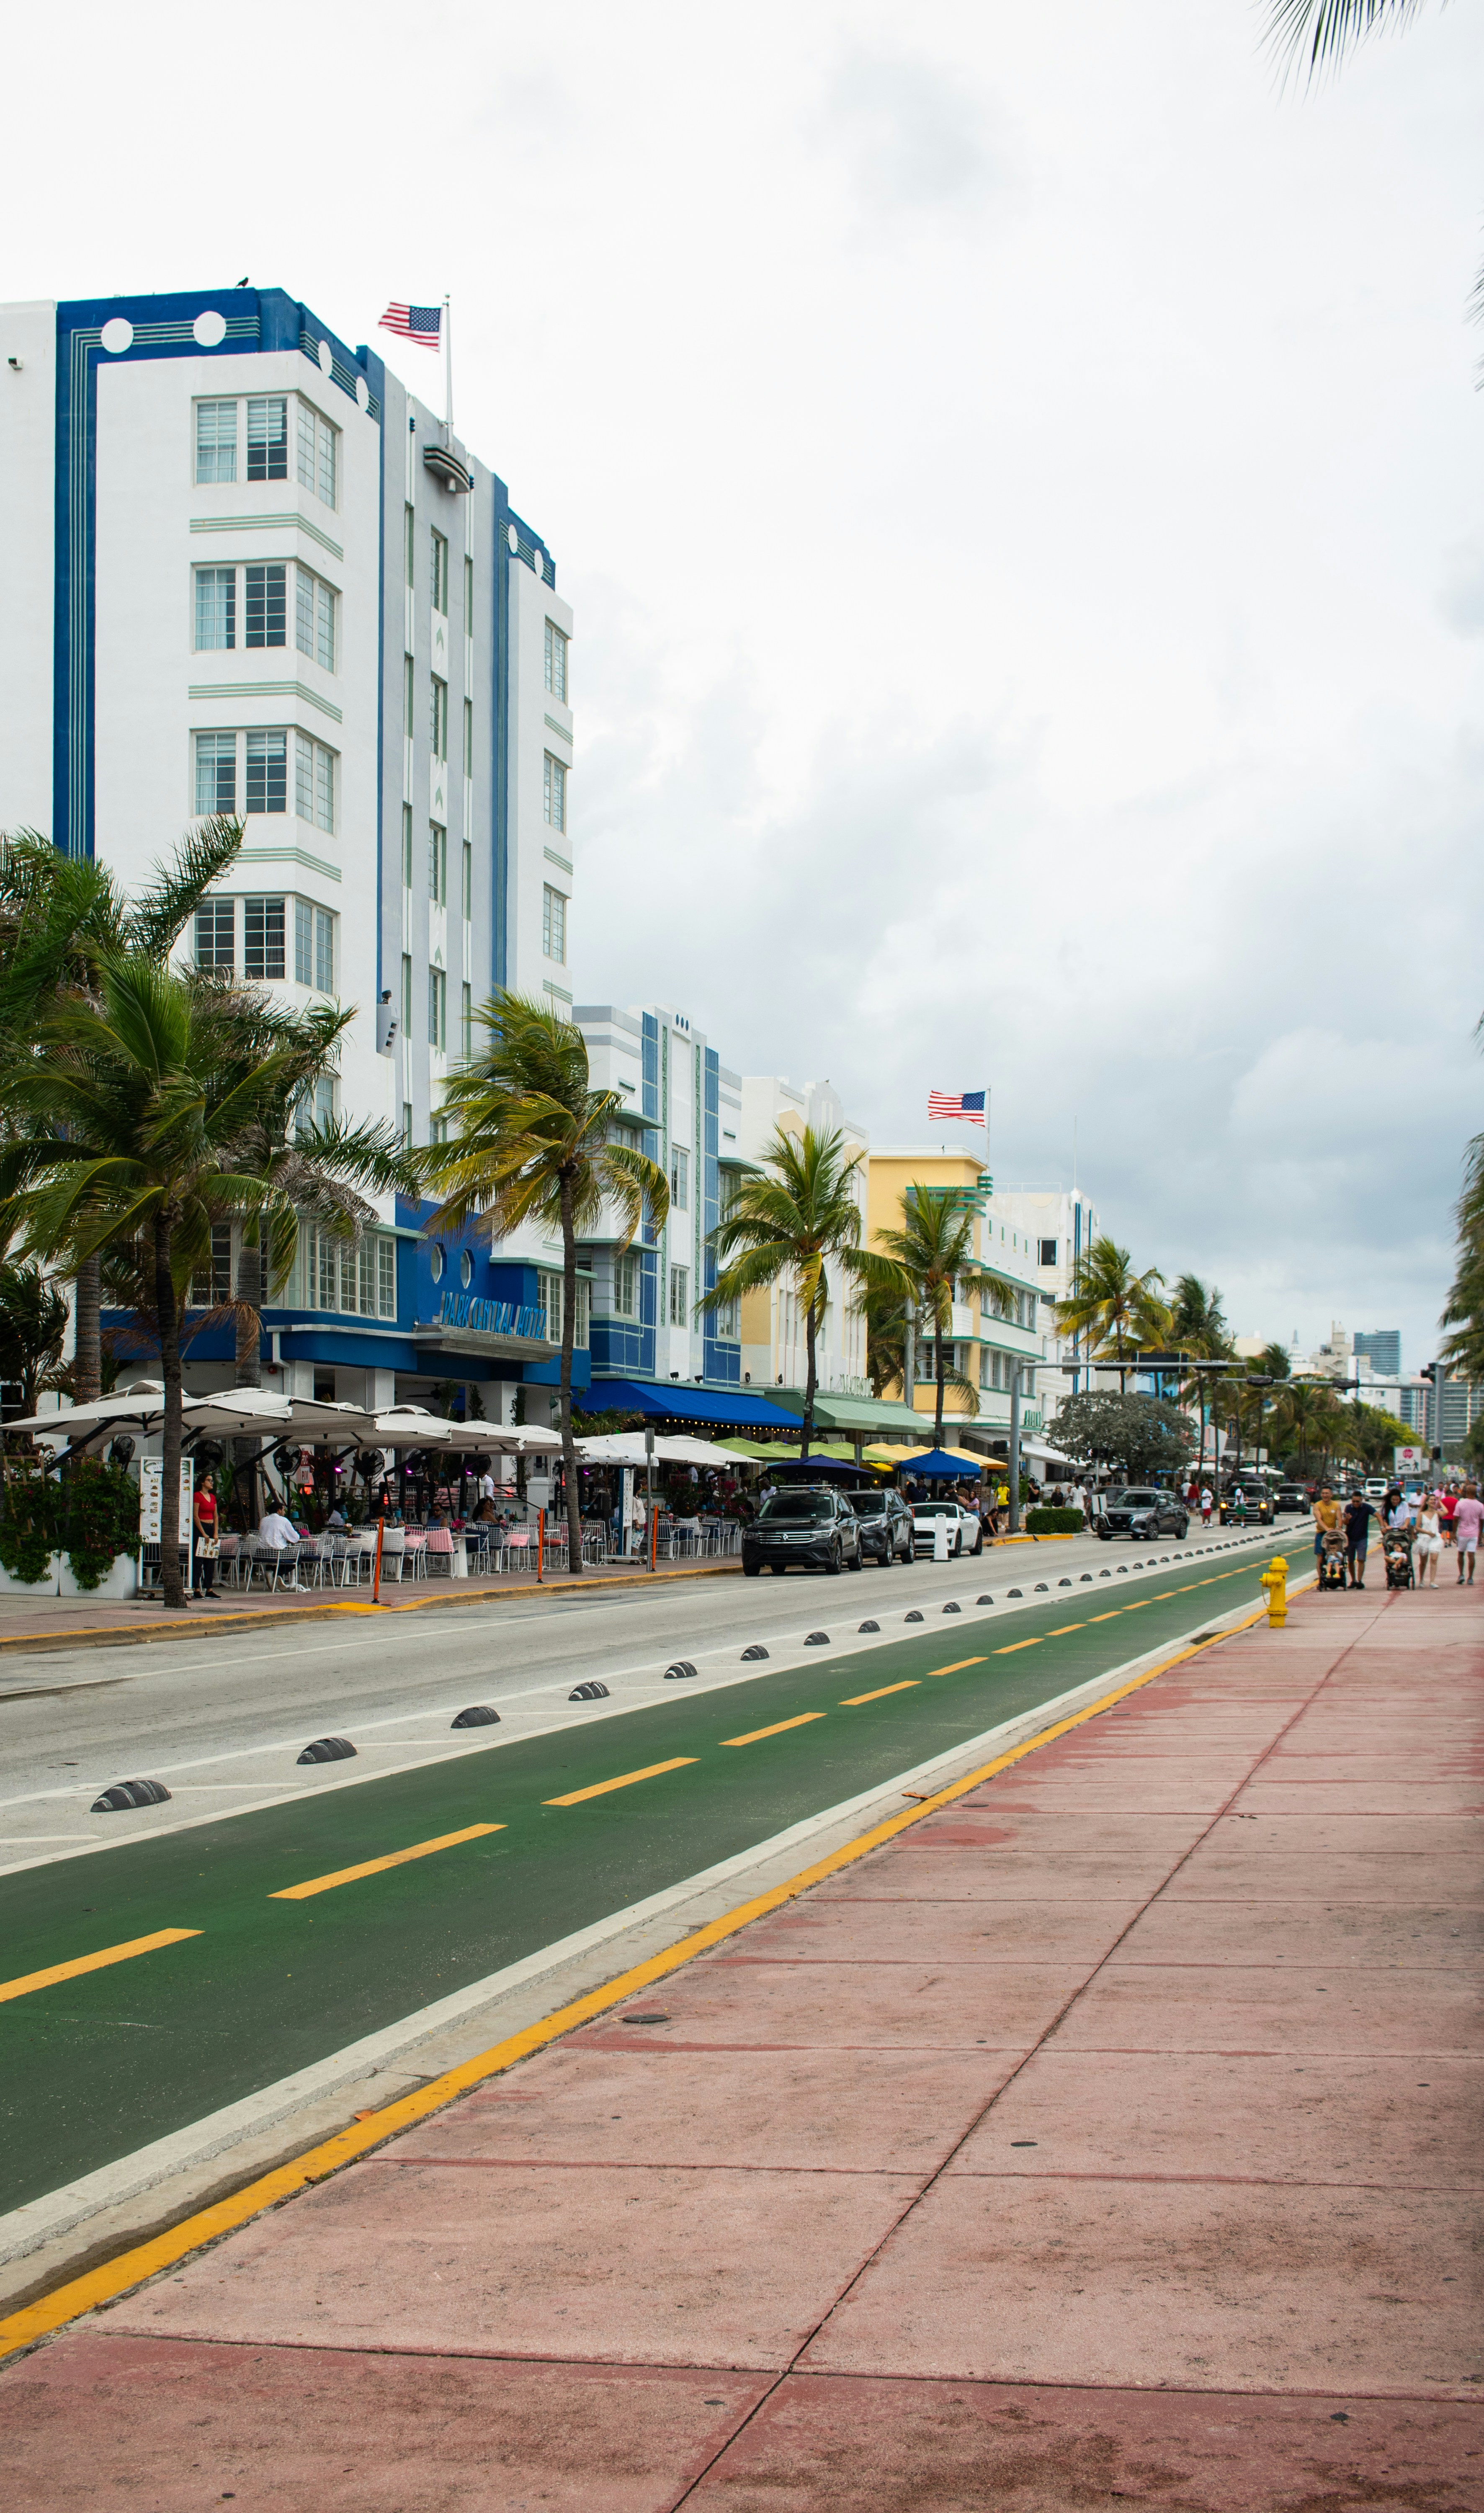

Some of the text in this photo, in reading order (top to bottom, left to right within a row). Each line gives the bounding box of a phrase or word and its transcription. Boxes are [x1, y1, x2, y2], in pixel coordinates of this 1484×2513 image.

[441, 1291, 547, 1340] PARK CENTRAL HOTEL
